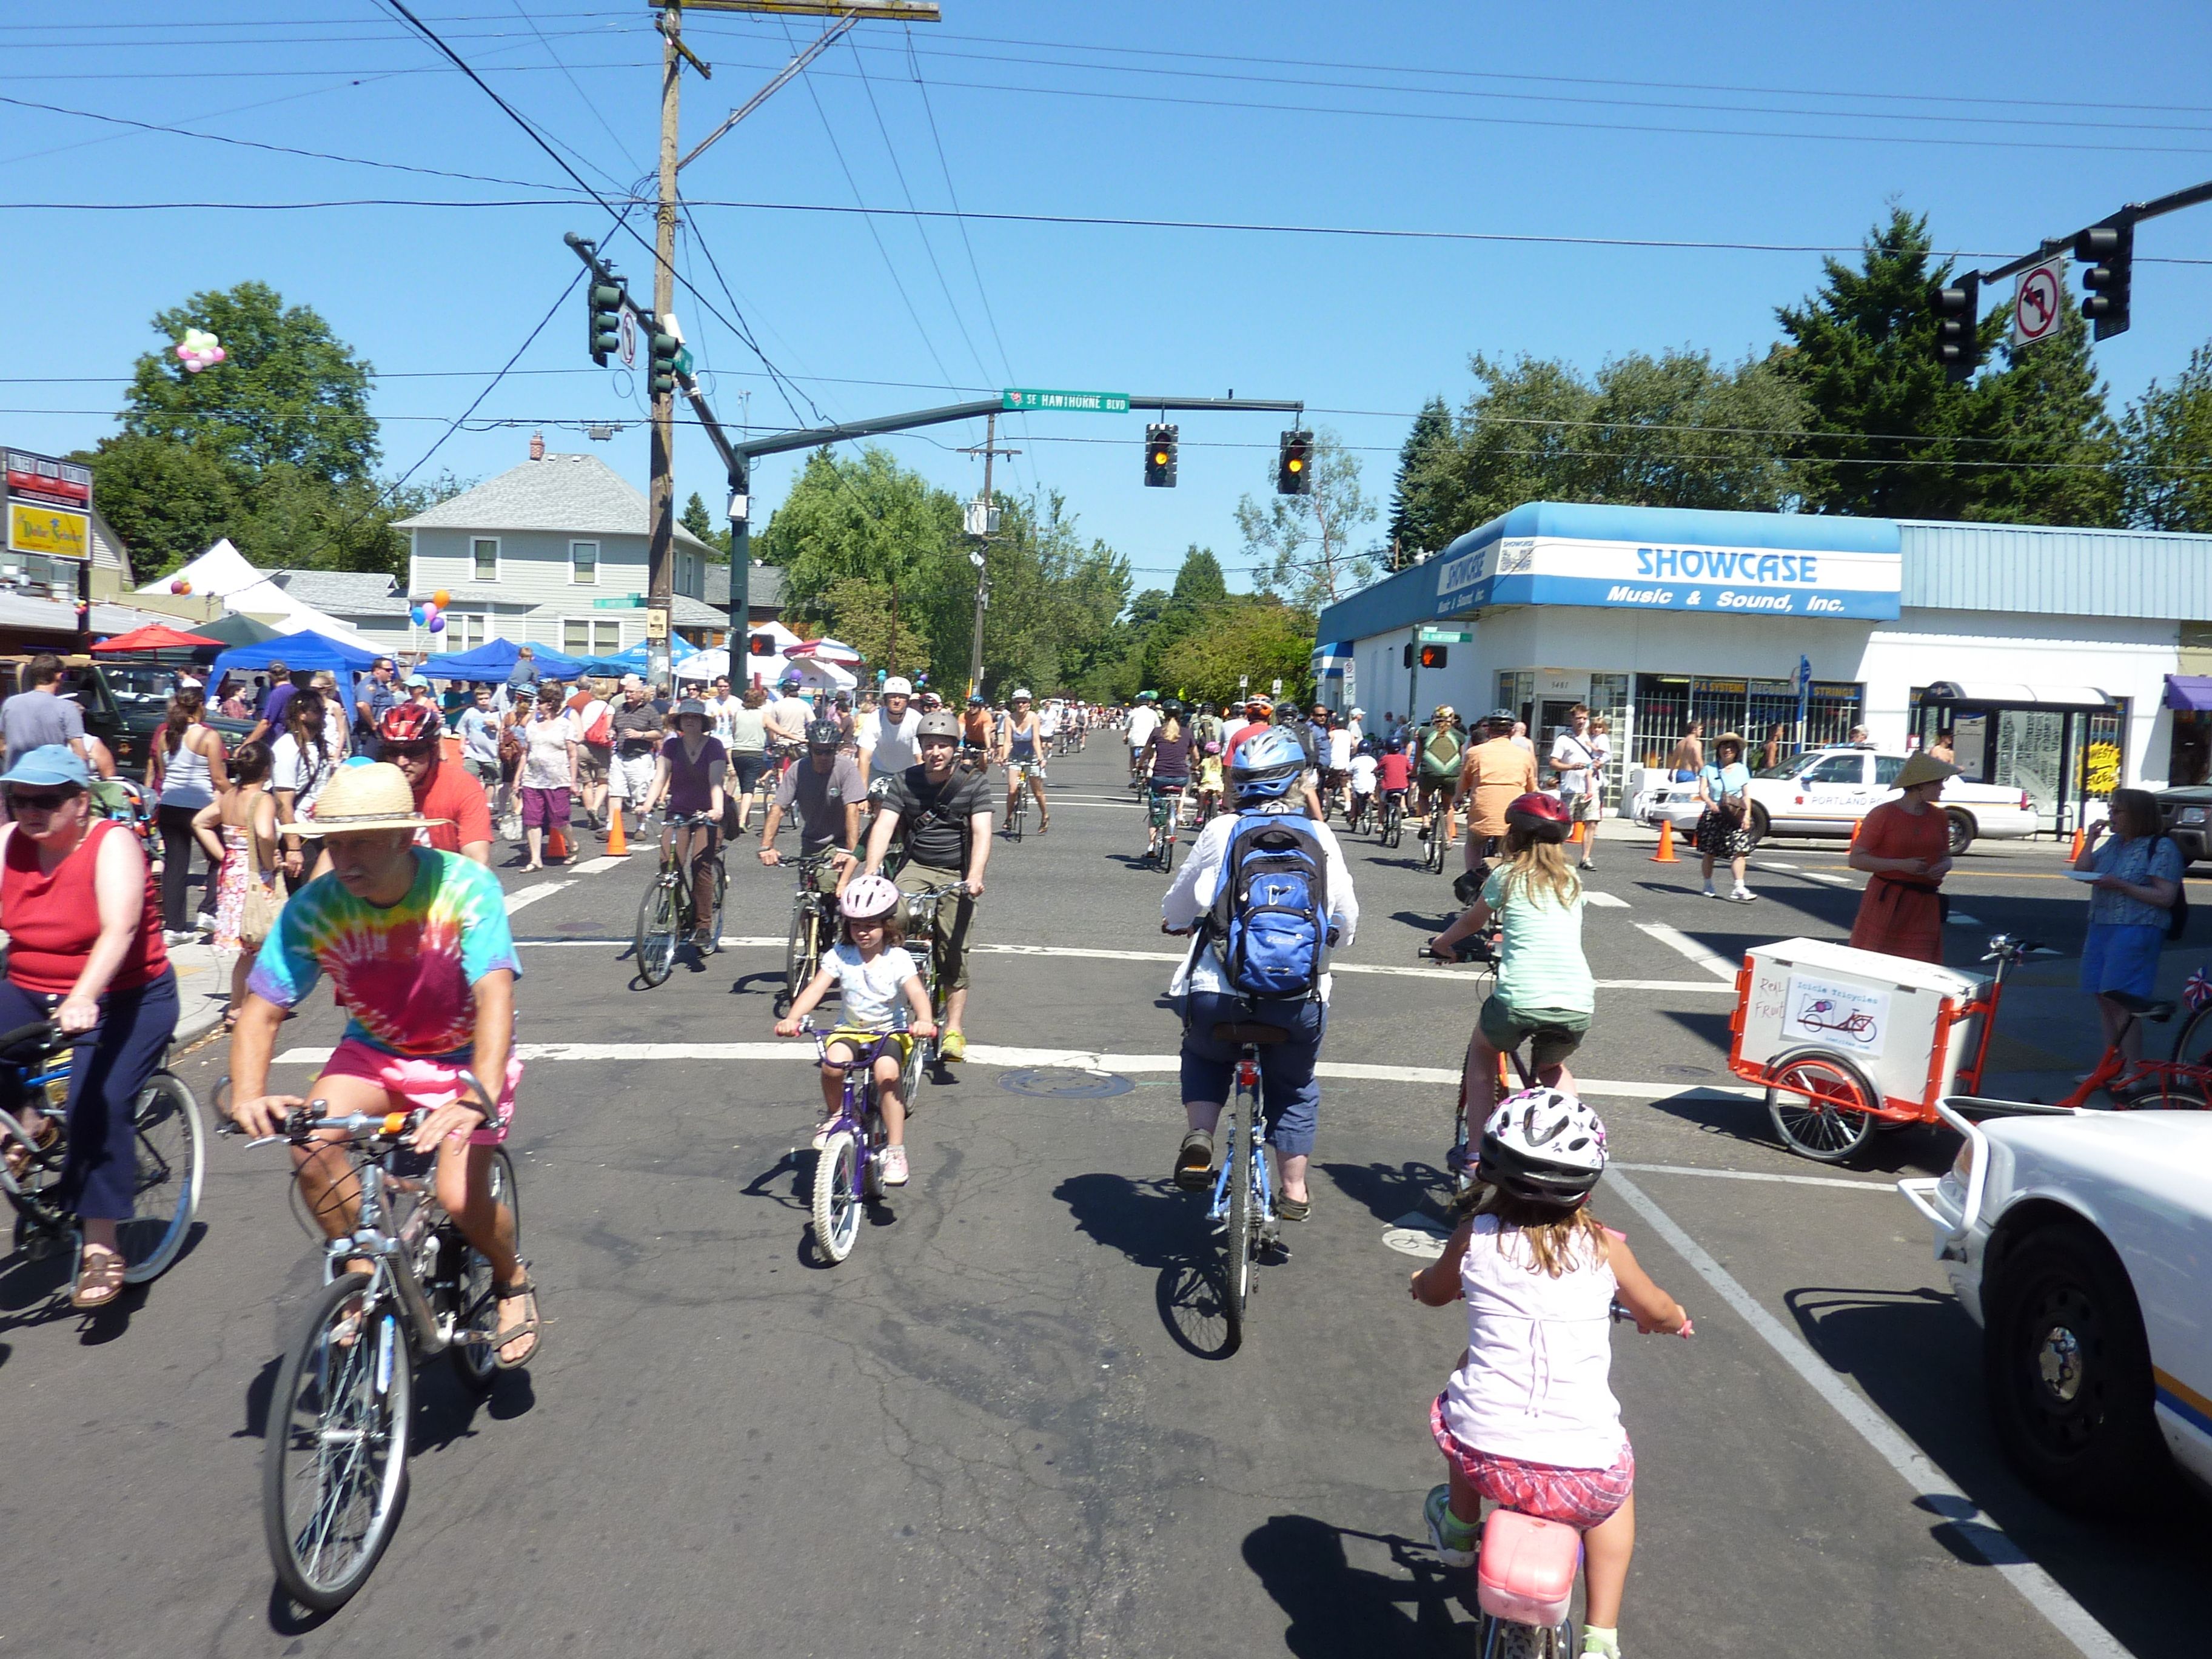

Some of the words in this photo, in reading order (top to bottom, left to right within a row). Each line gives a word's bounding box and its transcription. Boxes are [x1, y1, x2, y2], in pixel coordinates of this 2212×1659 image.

[1027, 394, 1037, 405] SE
[1041, 394, 1101, 409] HAWTHORNE
[1105, 398, 1126, 411] BLVD
[1637, 547, 1818, 583] SHOWCASE
[1606, 585, 1674, 605] Music
[1686, 590, 1701, 606] &
[1716, 590, 1794, 613] Sound,
[1806, 594, 1845, 612] Inc.
[1708, 682, 1746, 694] SYSTEMS
[1813, 686, 1856, 698] STRINGS
[1811, 796, 1867, 805] PORTLAND
[1797, 981, 1828, 994] Icicle
[1831, 988, 1879, 1005] Tricycles
